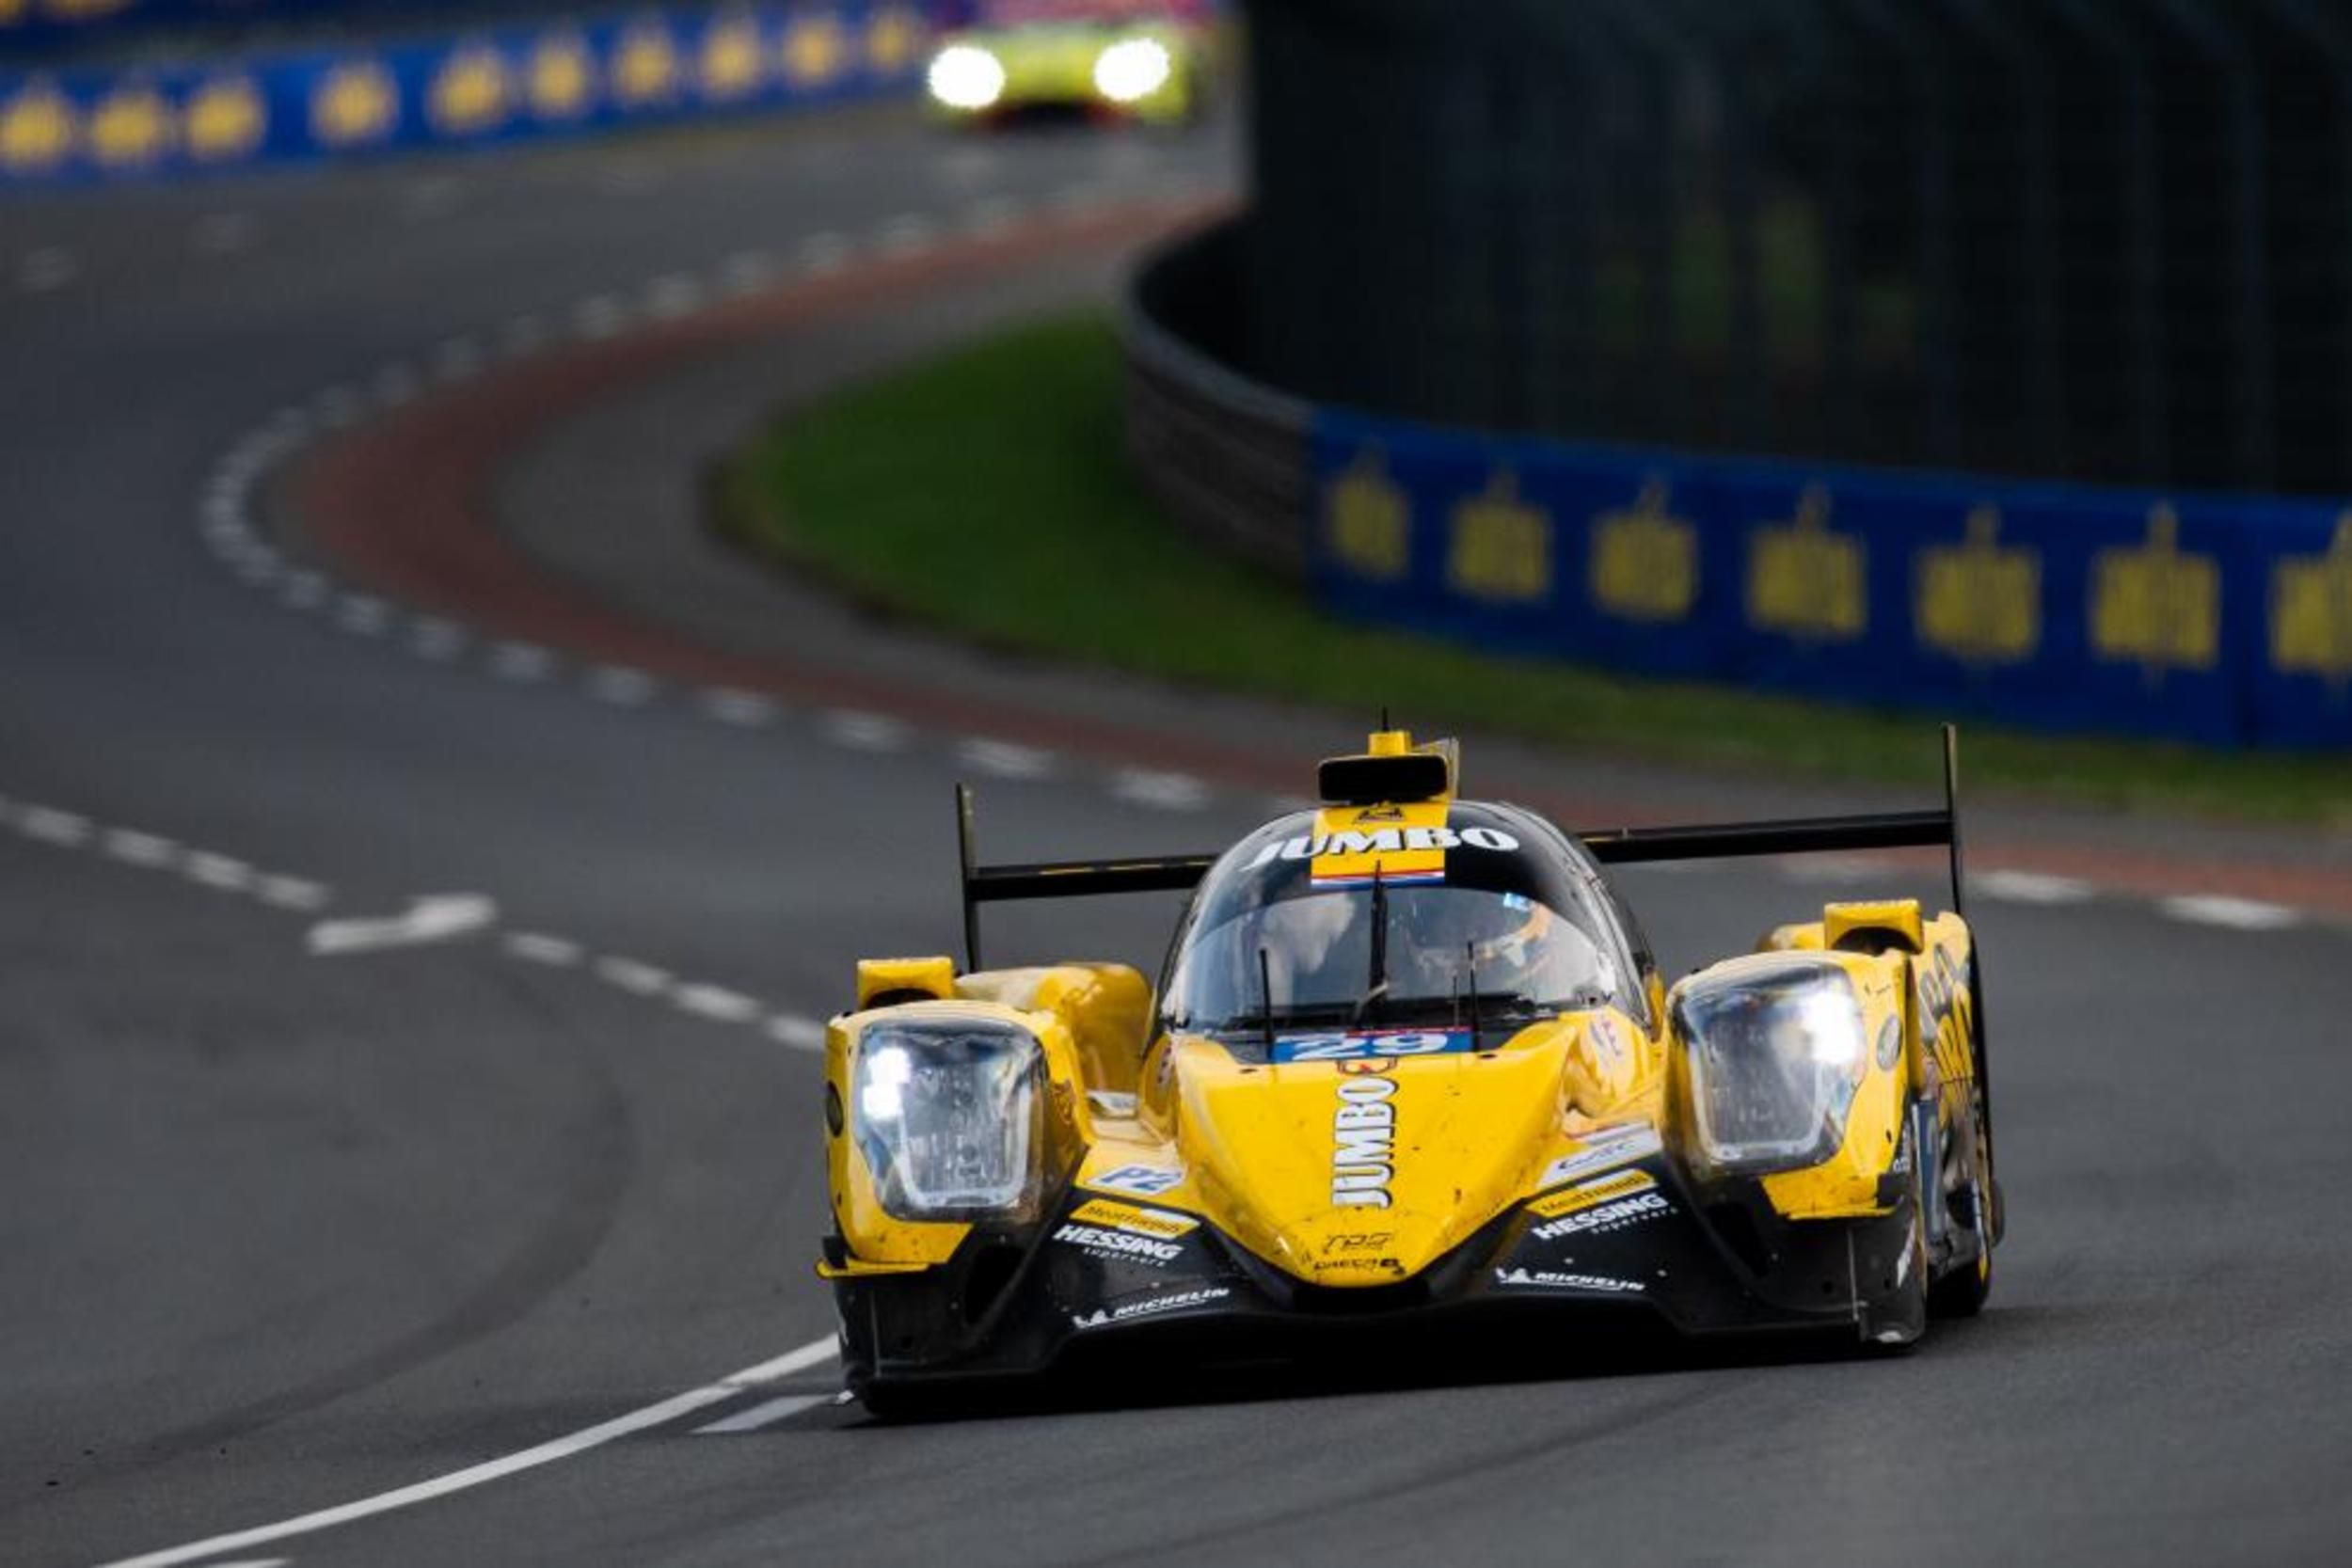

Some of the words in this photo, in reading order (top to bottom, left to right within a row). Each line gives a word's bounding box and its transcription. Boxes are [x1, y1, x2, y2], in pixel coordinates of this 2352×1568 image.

[1239, 827, 1519, 872] JUMBO
[1291, 1033, 1449, 1061] 29
[1330, 1075, 1397, 1209] JUMBO
[1531, 1192, 1669, 1241] HESSING
[1052, 1224, 1184, 1260] HESSING
[1535, 1272, 1646, 1291] MICHELIN
[1114, 1288, 1230, 1317] MICHELIN
